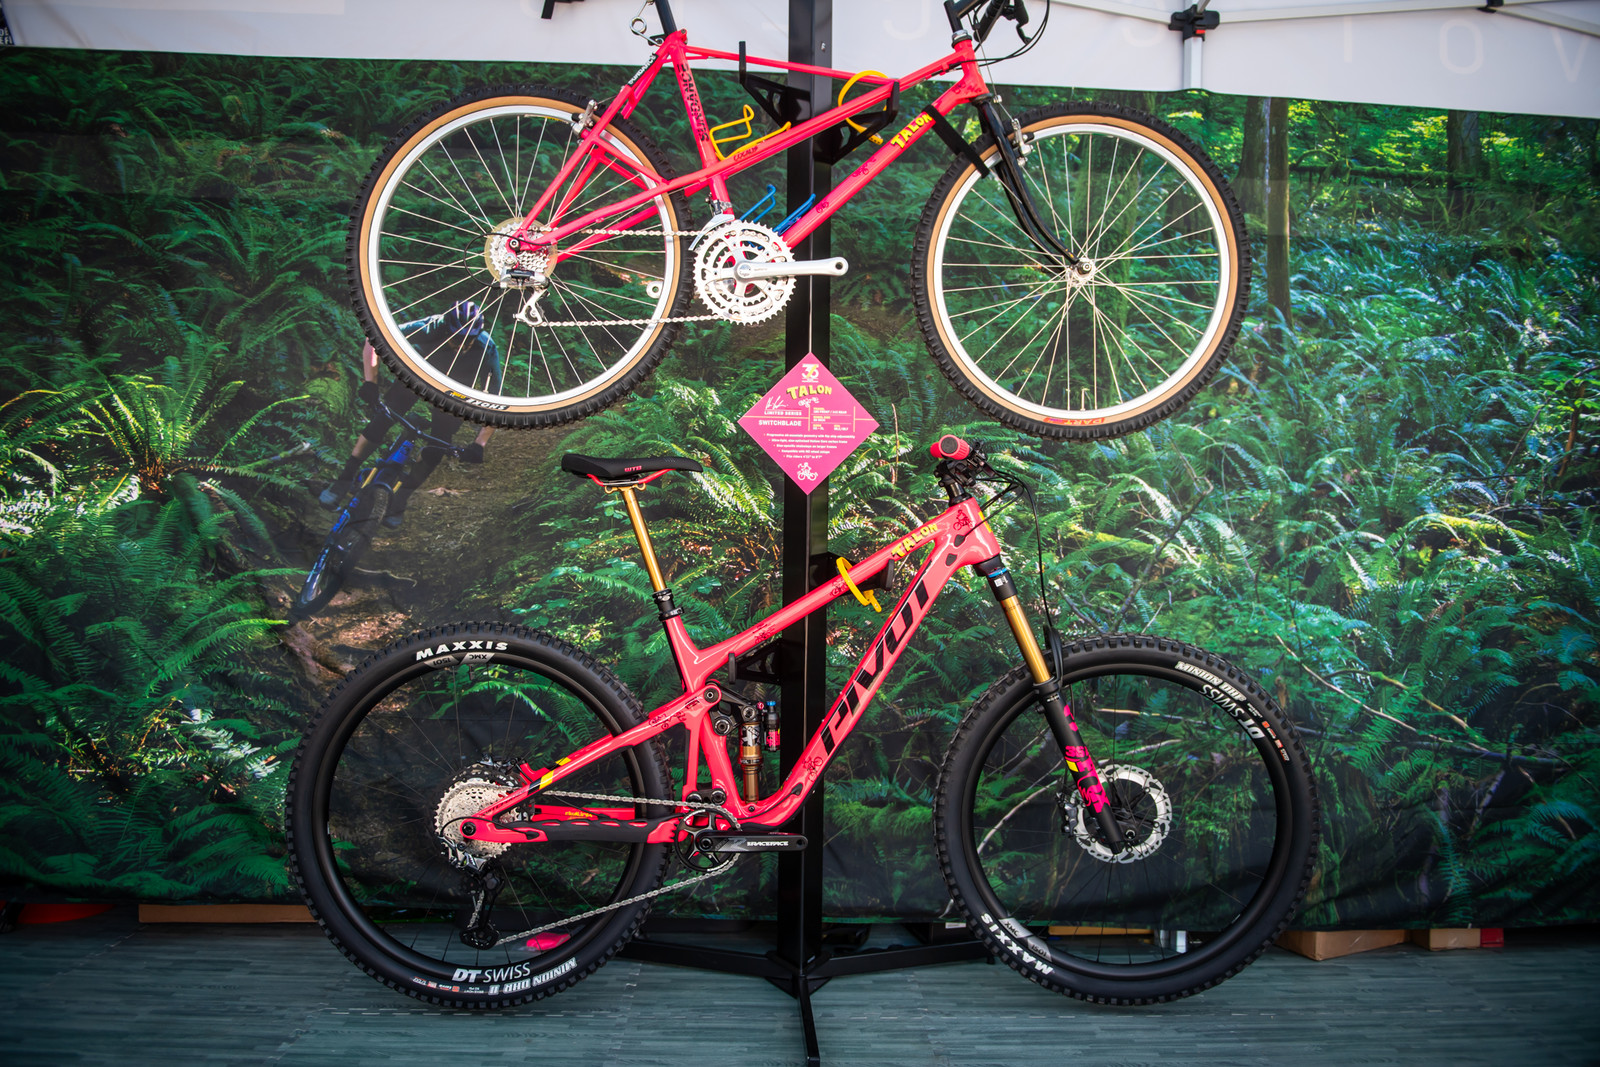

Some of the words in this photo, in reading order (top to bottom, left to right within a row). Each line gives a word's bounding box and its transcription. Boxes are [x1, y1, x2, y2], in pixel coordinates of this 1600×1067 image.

[677, 63, 709, 142] SUNDANCE
[891, 111, 933, 149] TALON
[786, 385, 832, 399] TALON
[758, 419, 802, 427] SWITCHBLADE
[891, 523, 939, 558] TALON
[416, 640, 509, 661] MAXXIS
[820, 560, 932, 756] PIVOT
[1175, 661, 1223, 686] MINION
[1202, 684, 1245, 717] SWISS
[1238, 718, 1265, 739] DT
[981, 913, 1053, 975] MAXXIS
[1004, 921, 1020, 936] XMC
[1031, 944, 1047, 957] 1501
[452, 968, 482, 983] DT
[482, 962, 531, 983] SWISS
[503, 978, 531, 994] DHR
[532, 957, 577, 987] MINION
